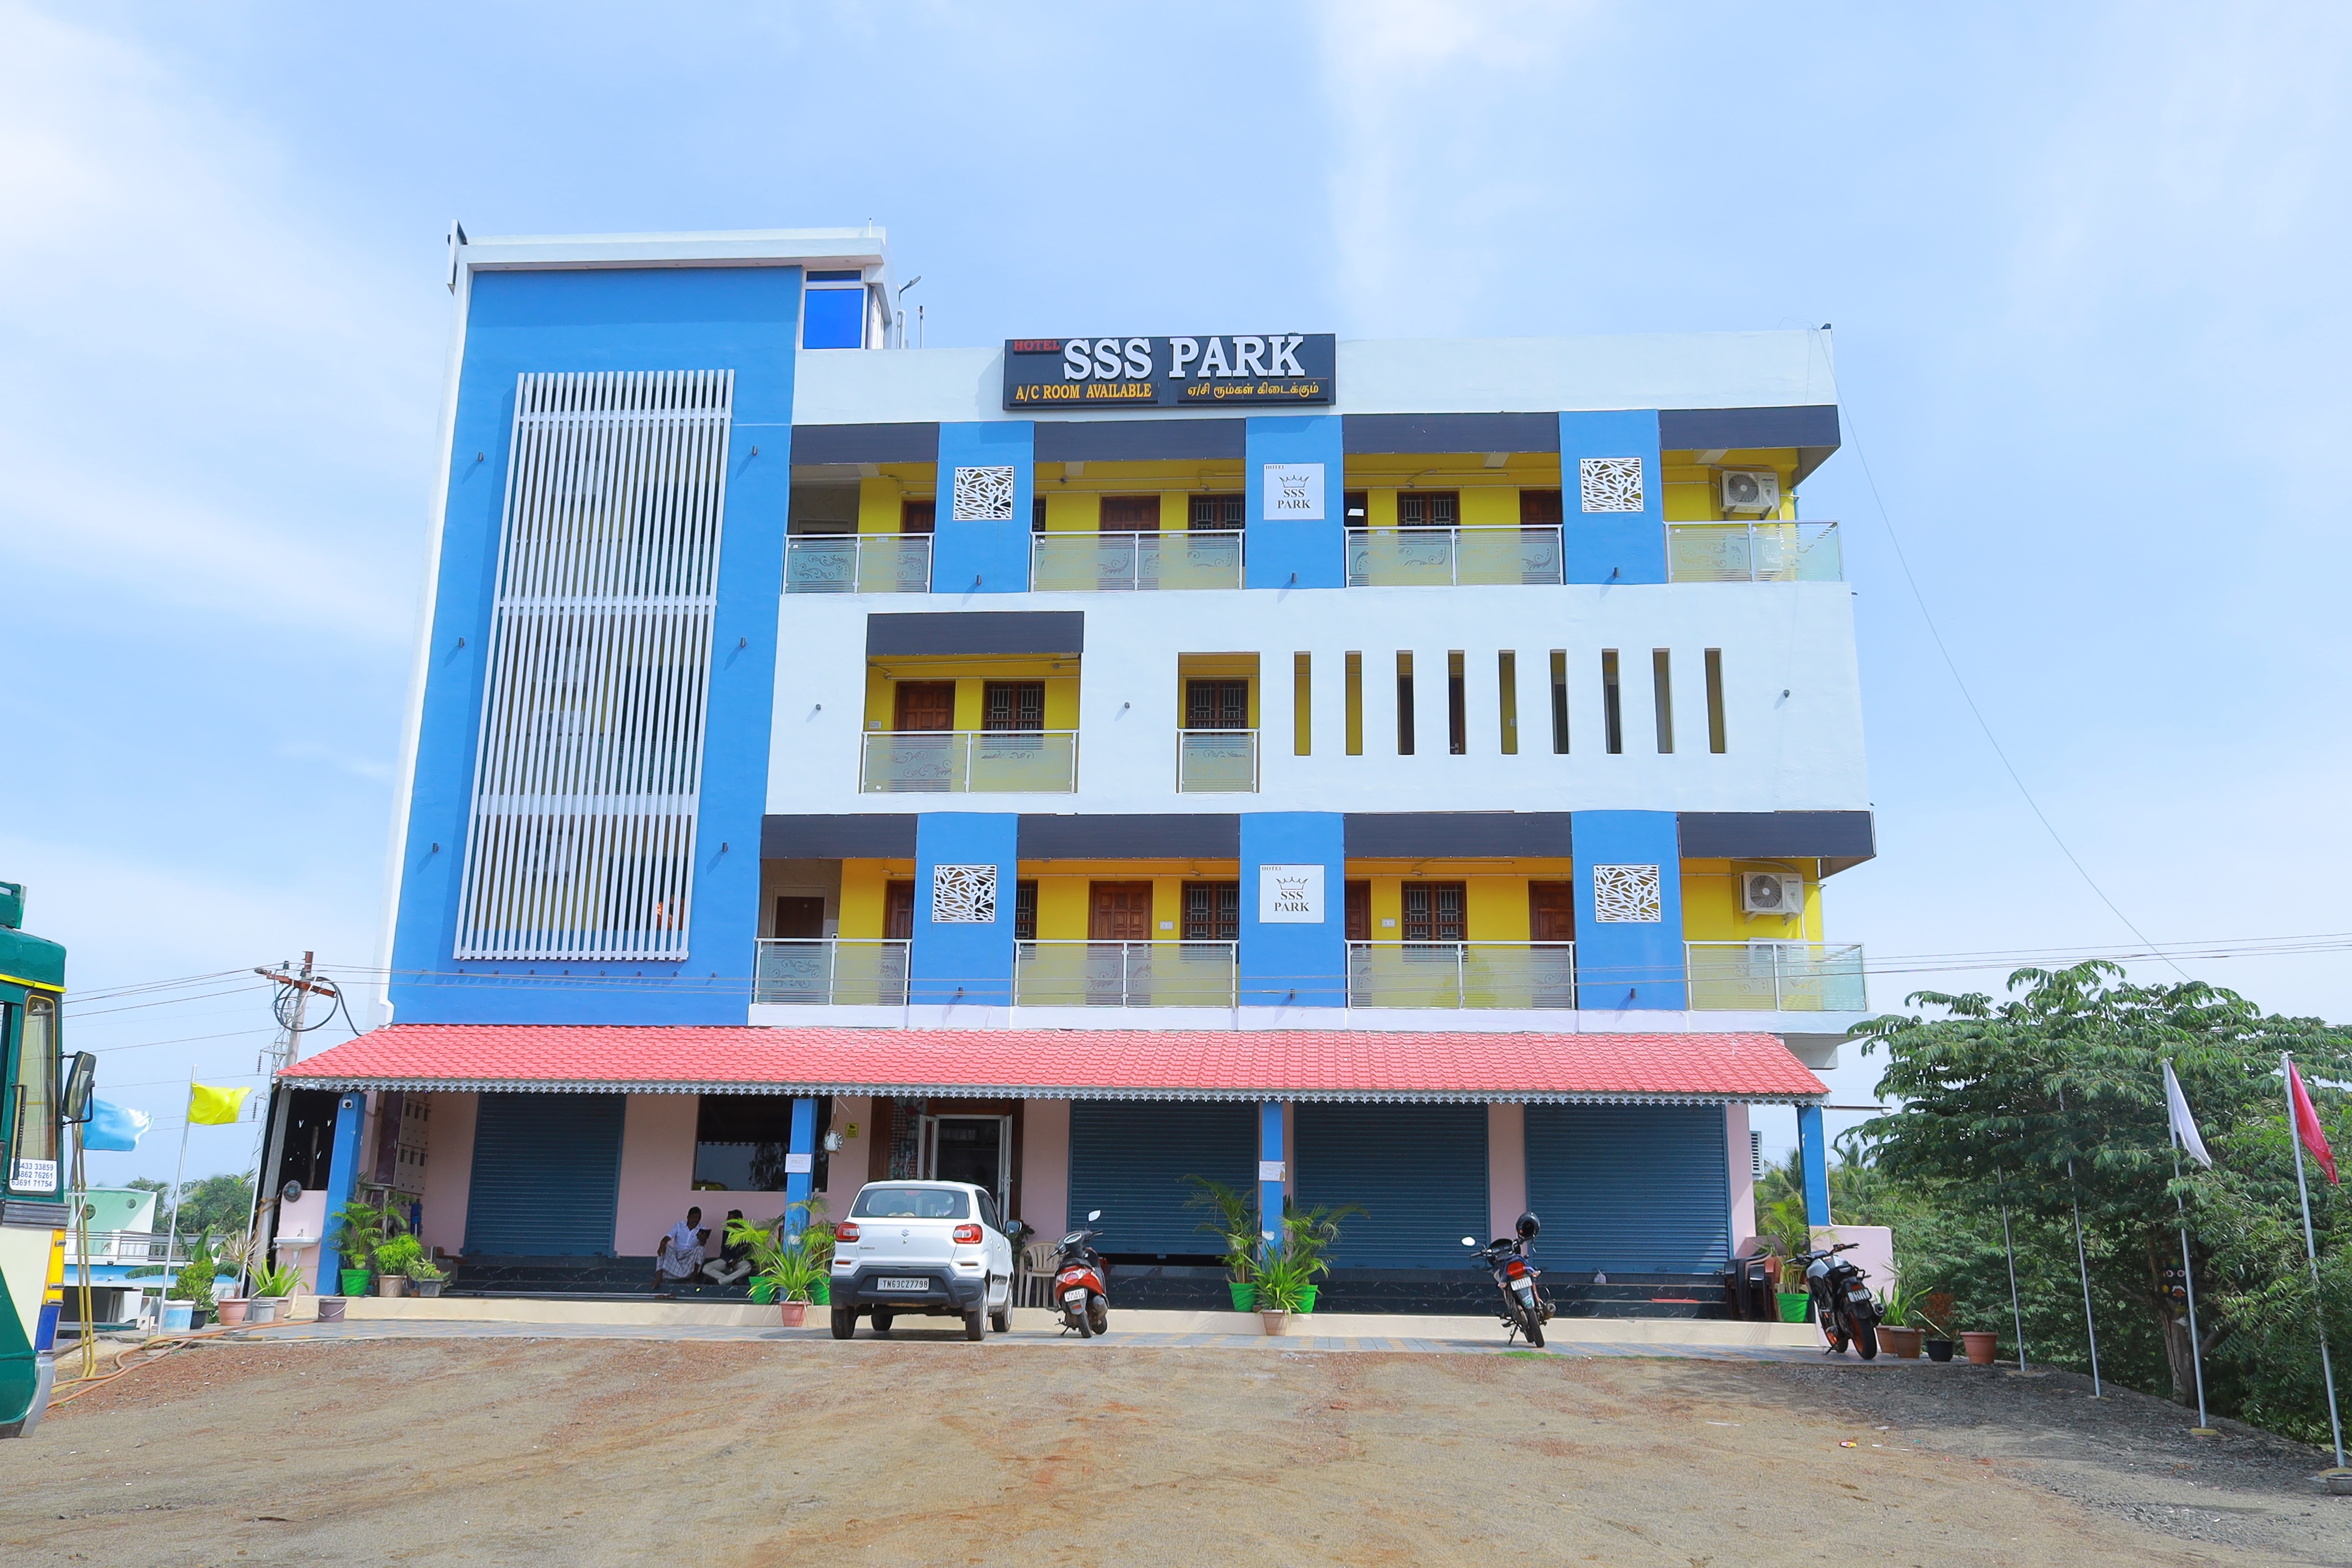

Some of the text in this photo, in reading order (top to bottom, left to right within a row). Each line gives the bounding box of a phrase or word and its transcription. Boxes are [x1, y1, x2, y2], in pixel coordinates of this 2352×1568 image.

[1014, 340, 1061, 351] HOTEL
[1063, 336, 1306, 380] SSS PARK
[1015, 384, 1152, 402] A/C ROOM AVAILABLE
[1257, 381, 1319, 398] கிடைக்கும்
[1283, 488, 1305, 498] SSS
[1277, 500, 1311, 509] PARK
[1280, 891, 1303, 900] SSS
[1274, 902, 1310, 912] PARK
[883, 1280, 928, 1288] TN63CZ7798
